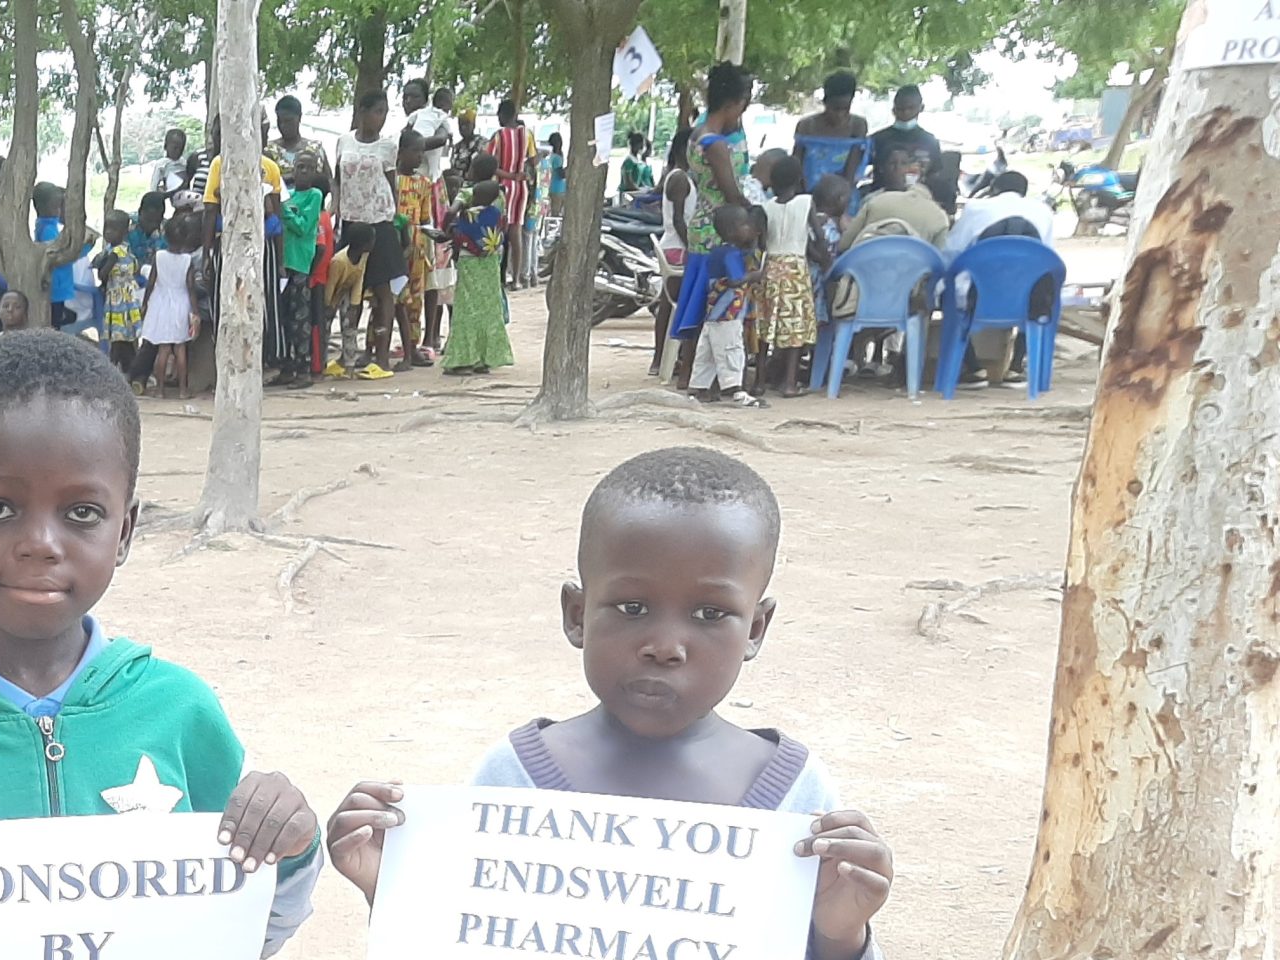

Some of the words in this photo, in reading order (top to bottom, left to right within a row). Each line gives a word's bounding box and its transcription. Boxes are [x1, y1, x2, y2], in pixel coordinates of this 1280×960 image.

[623, 46, 643, 74] 3
[471, 802, 639, 847] THANK
[652, 816, 760, 860] YOU
[469, 857, 737, 918] ENDSWELL
